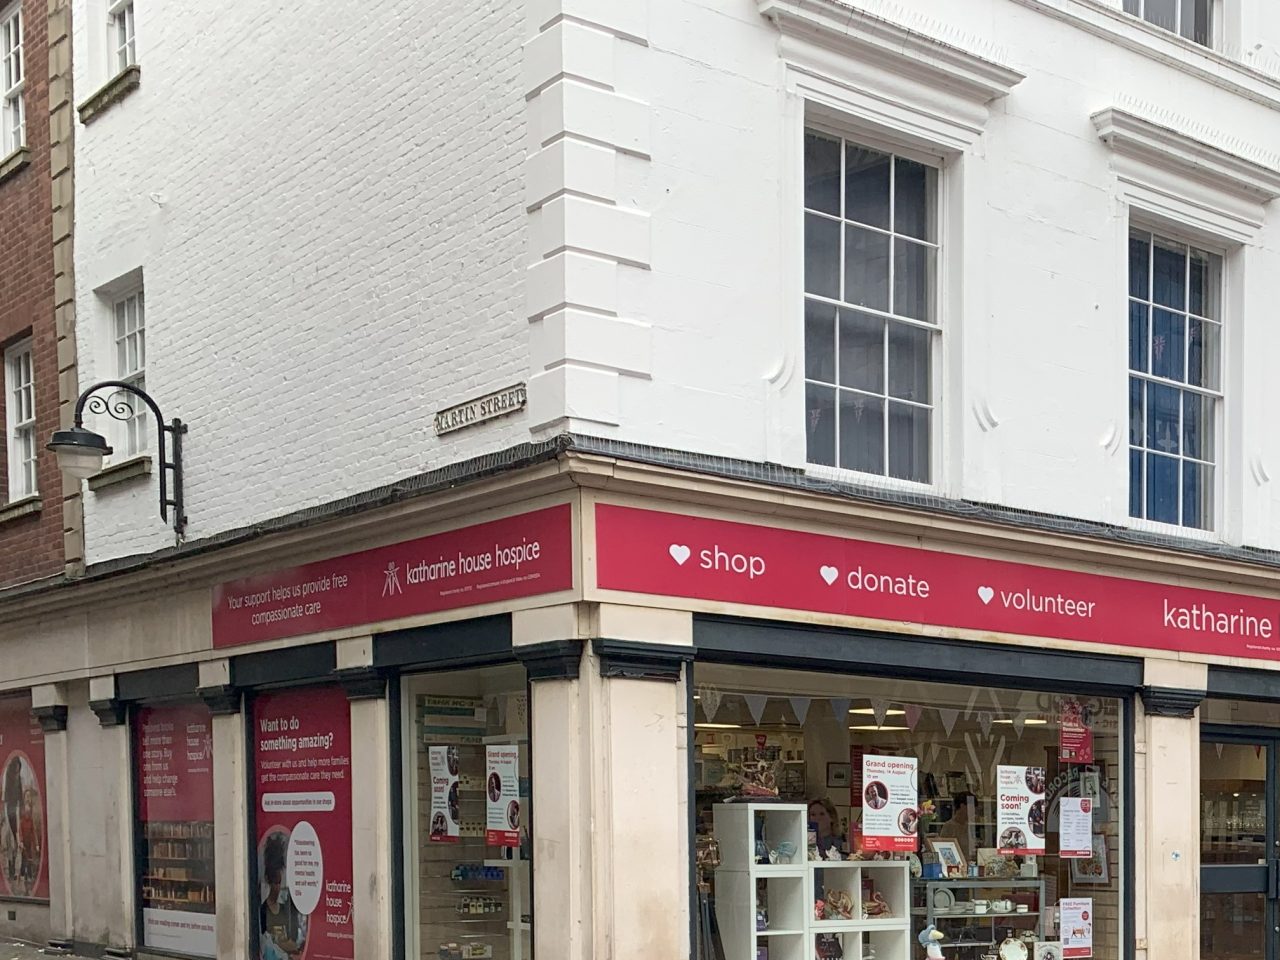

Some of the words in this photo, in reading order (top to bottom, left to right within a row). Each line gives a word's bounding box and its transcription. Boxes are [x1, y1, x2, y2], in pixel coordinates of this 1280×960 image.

[436, 404, 477, 431] MARTIN
[480, 388, 524, 416] STREET
[406, 557, 456, 585] katharine
[459, 552, 492, 575] house
[495, 537, 540, 570] hospice
[700, 545, 765, 579] shop
[228, 596, 242, 609] Your
[244, 591, 271, 608] support
[272, 587, 290, 602] helps
[292, 585, 300, 595] us
[302, 576, 330, 598] provide
[332, 573, 348, 589] free
[847, 566, 930, 598] donate
[251, 603, 303, 626] compassionate
[305, 601, 321, 616] care
[1001, 589, 1096, 618] volunteer
[1164, 599, 1272, 639] katharine
[260, 719, 278, 733] Want
[281, 718, 288, 731] to
[290, 716, 299, 730] do
[261, 735, 297, 752] something
[299, 732, 333, 749] amazing?
[865, 760, 885, 768] Grand
[887, 761, 914, 770] opening
[1000, 793, 1029, 803] Coming
[1001, 802, 1022, 810] soon!
[325, 880, 351, 893] katharine
[326, 896, 342, 908] house
[326, 911, 347, 927] hospice
